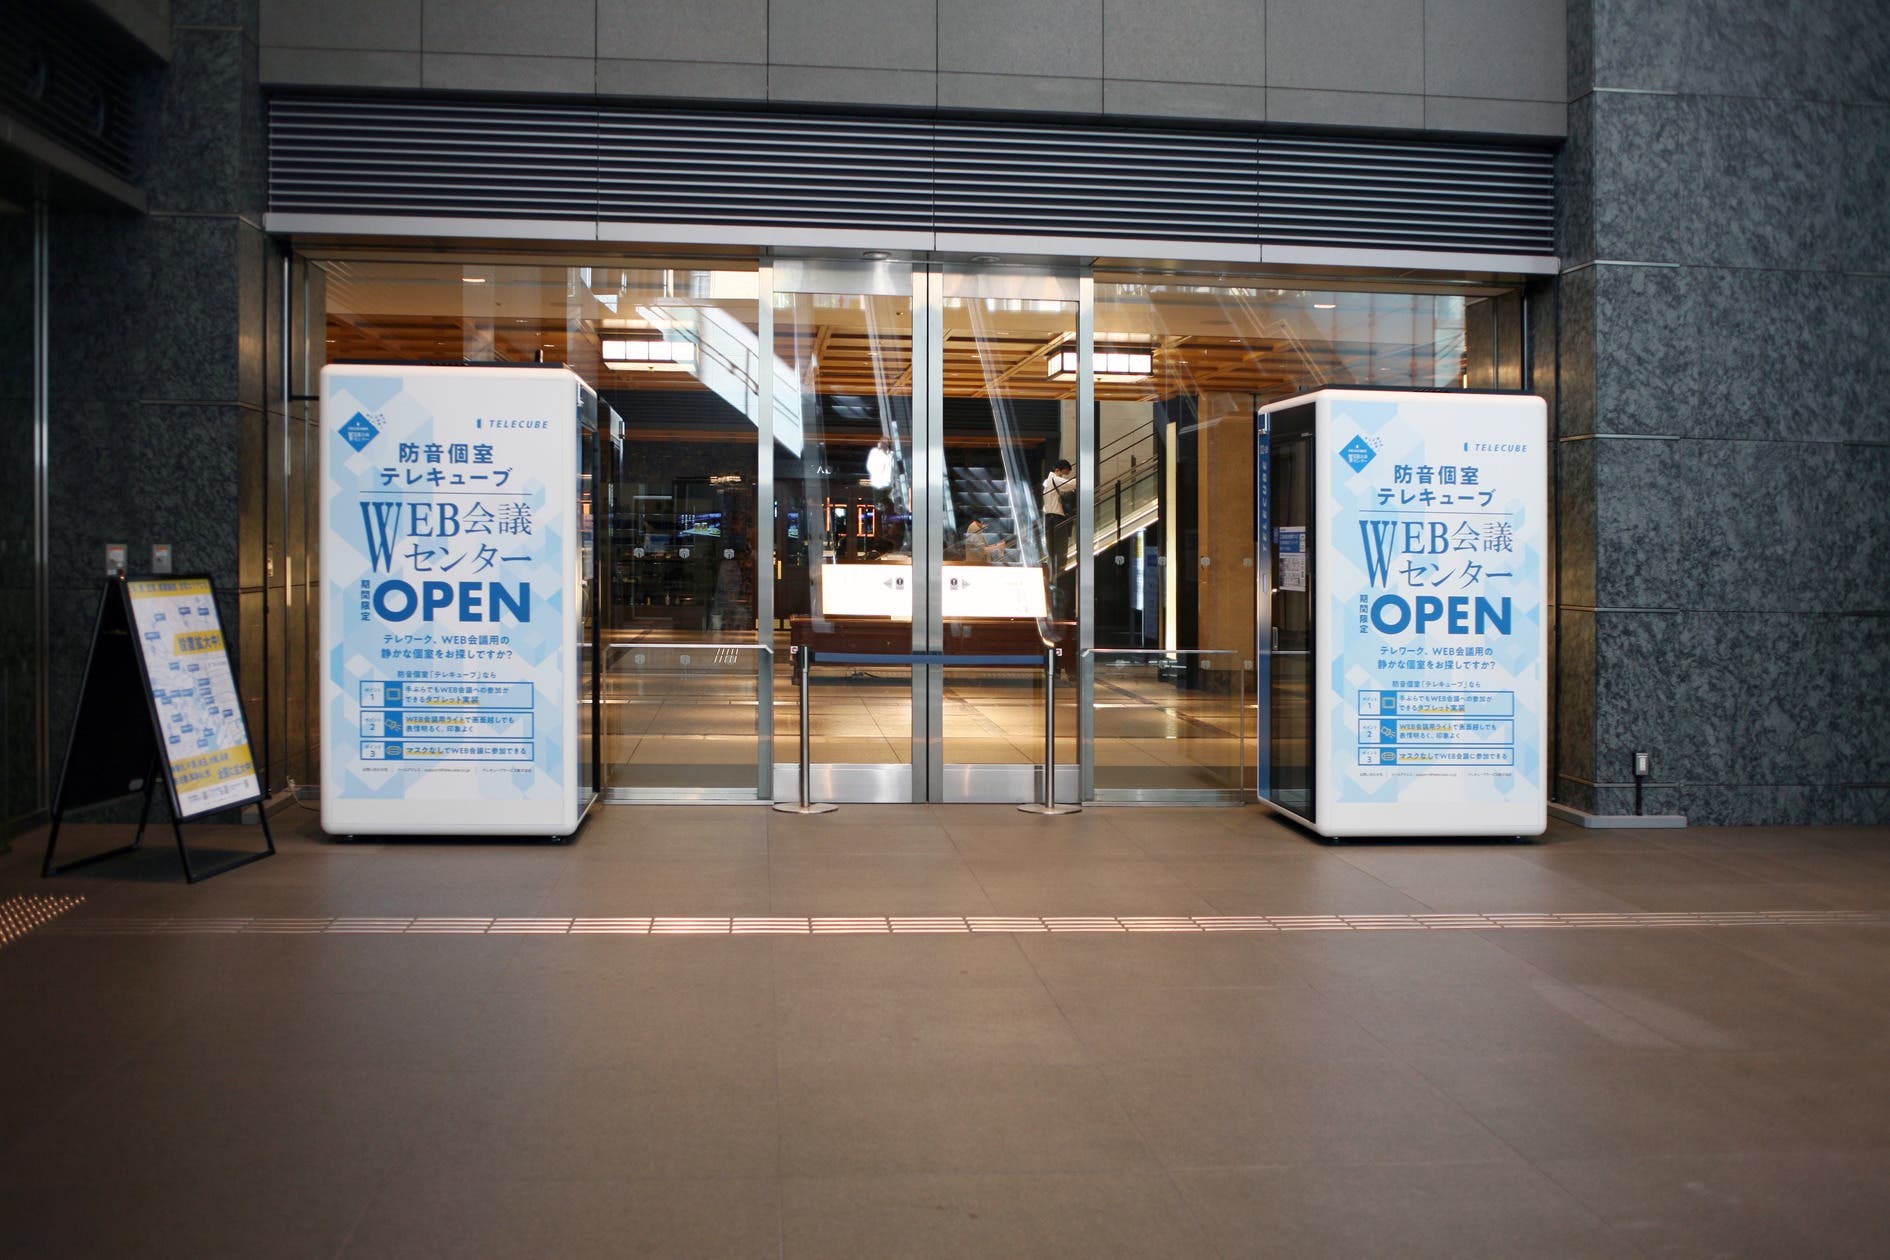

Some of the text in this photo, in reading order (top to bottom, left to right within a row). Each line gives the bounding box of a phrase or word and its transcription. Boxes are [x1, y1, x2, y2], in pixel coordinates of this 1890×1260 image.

[489, 419, 549, 429] TELECUBE
[399, 443, 494, 464] 防音個室
[1474, 443, 1528, 453] TELECUBE
[380, 466, 513, 487] テレキューブ
[1394, 464, 1480, 485] 防音個室
[1261, 460, 1269, 552] TELECUBE
[1377, 488, 1497, 507] テレキューブ
[404, 543, 532, 574] センター
[1399, 560, 1513, 589] センター
[373, 579, 531, 623] OPEN
[1359, 594, 1369, 634] 期間限定
[1370, 594, 1512, 635] OPEN
